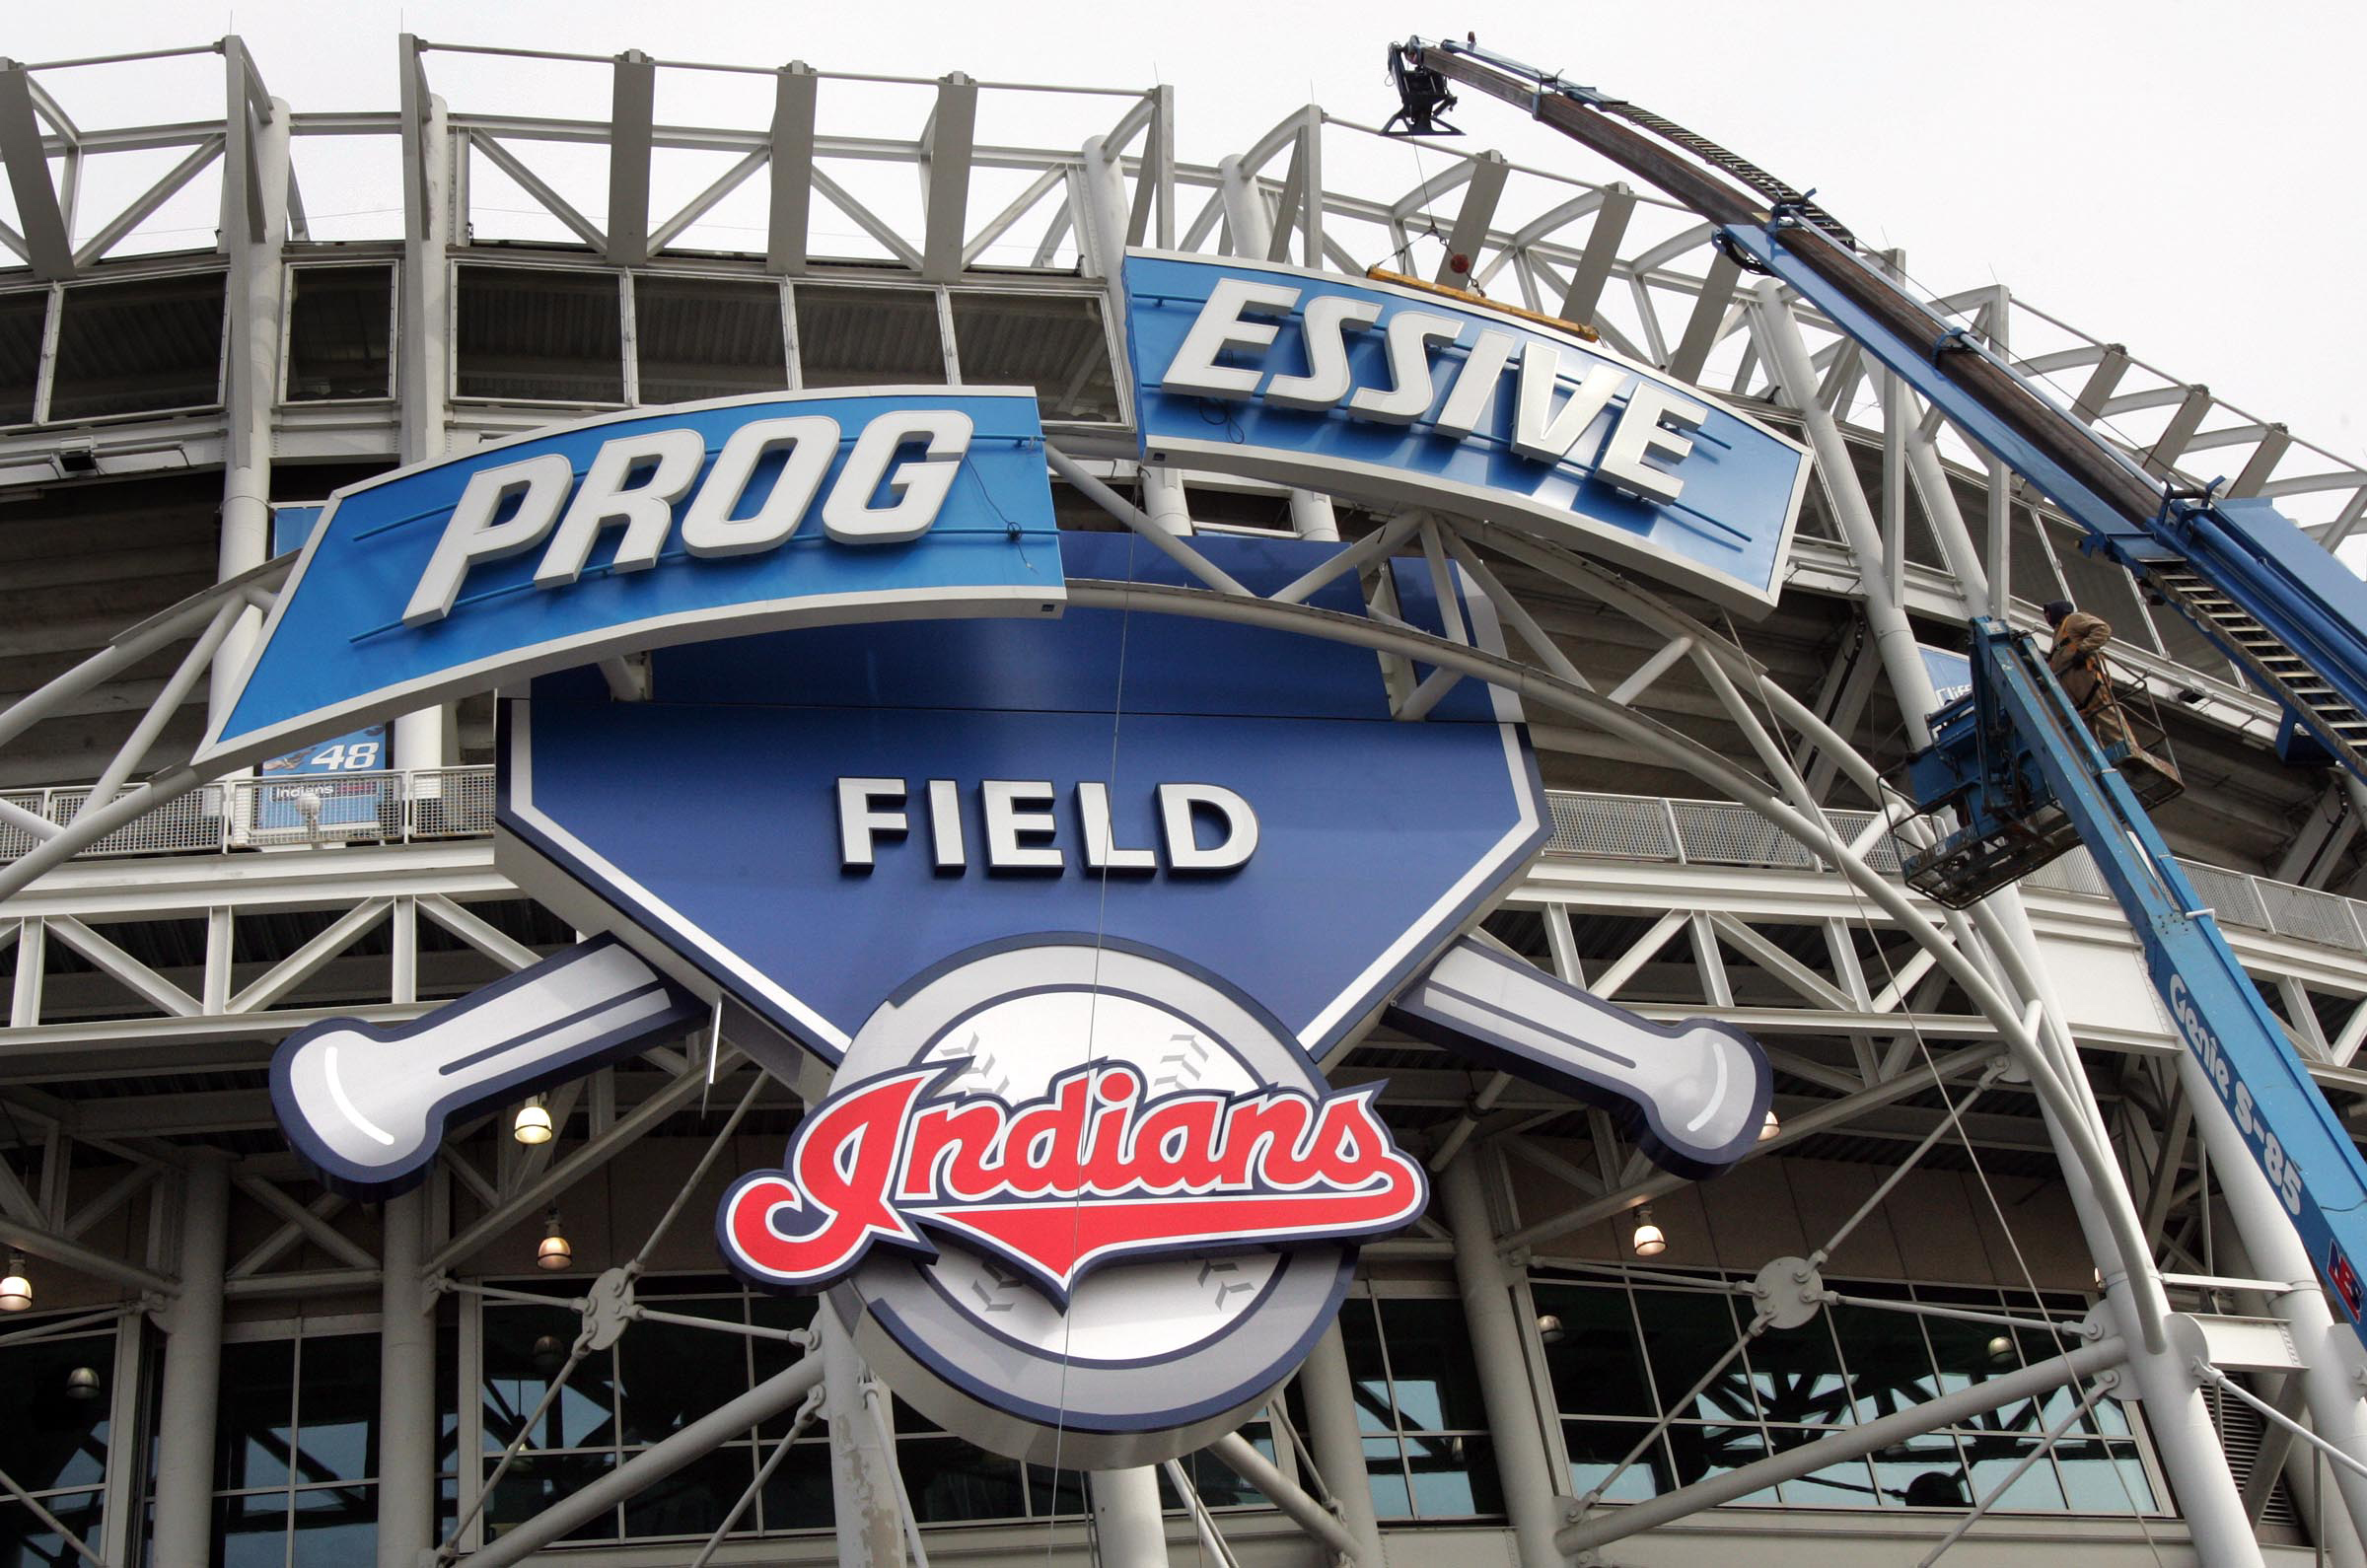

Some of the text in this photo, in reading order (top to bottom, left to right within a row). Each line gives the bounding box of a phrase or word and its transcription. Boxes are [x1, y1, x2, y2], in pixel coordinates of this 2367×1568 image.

[1162, 277, 1707, 506] ESSIVE
[402, 409, 974, 628] PROG
[276, 784, 334, 798] Indians
[311, 742, 380, 770] 48
[835, 776, 1260, 876] FIELD
[716, 1055, 1429, 1300] Indians
[2170, 973, 2302, 1215] Genie S-85
